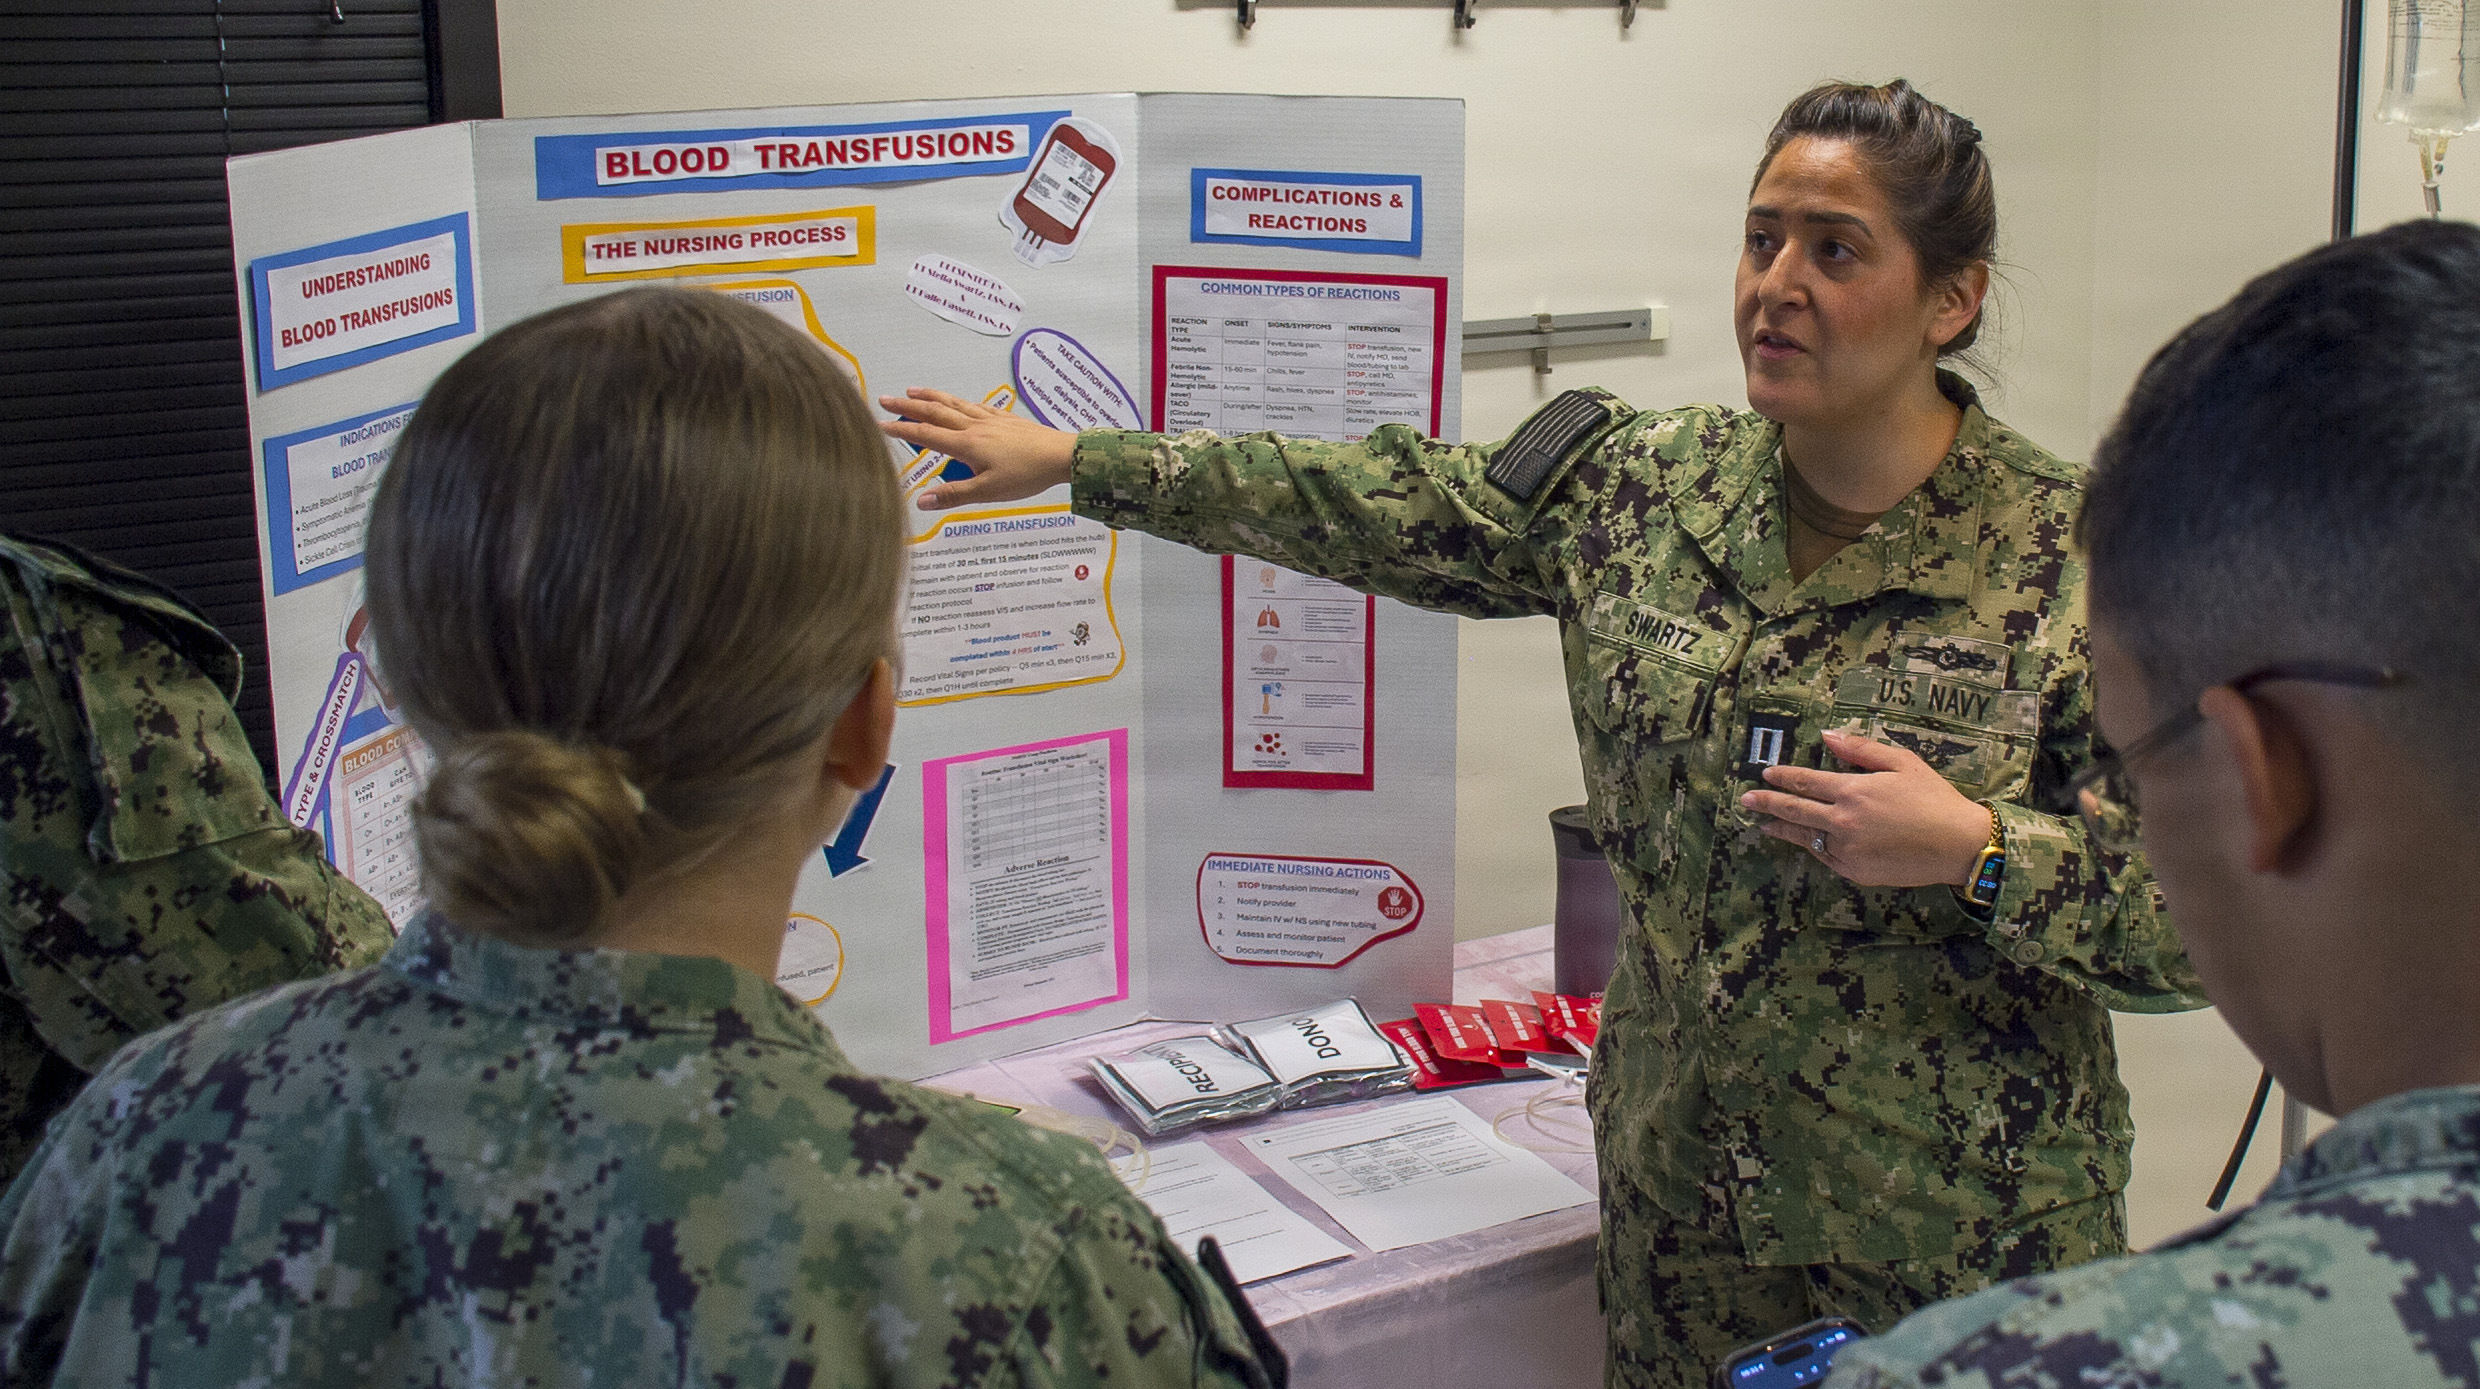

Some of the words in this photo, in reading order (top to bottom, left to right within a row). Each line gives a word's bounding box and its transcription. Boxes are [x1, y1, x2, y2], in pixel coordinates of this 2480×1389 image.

[605, 146, 730, 178] BLOOD
[753, 129, 1016, 170] TRANSFUSIONS
[1211, 185, 1382, 208] COMPLICATIONS
[1389, 192, 1404, 209] &
[1248, 213, 1367, 234] REACTIONS
[592, 242, 637, 260] THE
[643, 233, 744, 256] NURSING
[750, 225, 847, 249] PROCESS
[301, 253, 430, 299] UNDERSTANDING
[1201, 281, 1261, 295] COMMON
[1265, 284, 1304, 297] TYPES
[1307, 286, 1323, 298] OF
[1327, 287, 1400, 302] REACTIONS
[281, 317, 337, 349] BLOOD
[340, 287, 454, 334] TRANSFUSIONS
[1267, 321, 1331, 330] SIGNS/SYMPTOMS
[1348, 324, 1400, 333] INTERVENTION
[1029, 342, 1056, 370] Patients
[1055, 368, 1093, 404] susceptible
[1091, 400, 1100, 410] to
[1057, 343, 1076, 364] TAKE
[1073, 359, 1105, 391] CAUTION
[1102, 385, 1123, 408] WITH:
[1026, 379, 1053, 406] Multiple
[1051, 403, 1068, 420] past
[1053, 385, 1079, 413] dialysis,
[1080, 408, 1098, 427] CHF)
[339, 416, 401, 448] INDICATIONS
[331, 456, 365, 480] BLOOD
[944, 523, 990, 537] DURING
[993, 515, 1076, 532] TRANSFUSION
[974, 583, 994, 591] STOP
[917, 615, 930, 623] NO
[1624, 610, 1702, 655] SWARTZ
[1879, 677, 1916, 707] U.S.
[1928, 683, 1992, 722] NAVY
[313, 662, 356, 769] CROSSMATCH
[344, 744, 383, 773] BLOOD
[309, 771, 320, 783] &
[294, 788, 315, 822] TYPE
[1208, 860, 1274, 873] IMMEDIATE
[1277, 863, 1333, 876] NURSING
[1335, 867, 1390, 879] ACTIONS
[1237, 881, 1259, 889] STOP
[1261, 882, 1307, 892] transfusion
[1309, 885, 1359, 895] immediately
[1218, 896, 1225, 904] 2.
[1237, 897, 1260, 906] Notify
[1262, 898, 1295, 908] provider
[1384, 906, 1406, 917] STOP
[1237, 913, 1272, 923] Maintain
[1273, 915, 1280, 923] IV
[1295, 916, 1306, 925] NS
[1308, 917, 1330, 926] using
[1332, 918, 1348, 927] new
[1350, 919, 1376, 929] tubing
[1216, 928, 1224, 936] 4.
[1235, 929, 1265, 938] Assess
[1267, 931, 1281, 939] and
[1283, 932, 1314, 941] monitor
[1317, 934, 1345, 943] patient
[1235, 945, 1278, 956] Document
[1280, 948, 1323, 958] thoroughly
